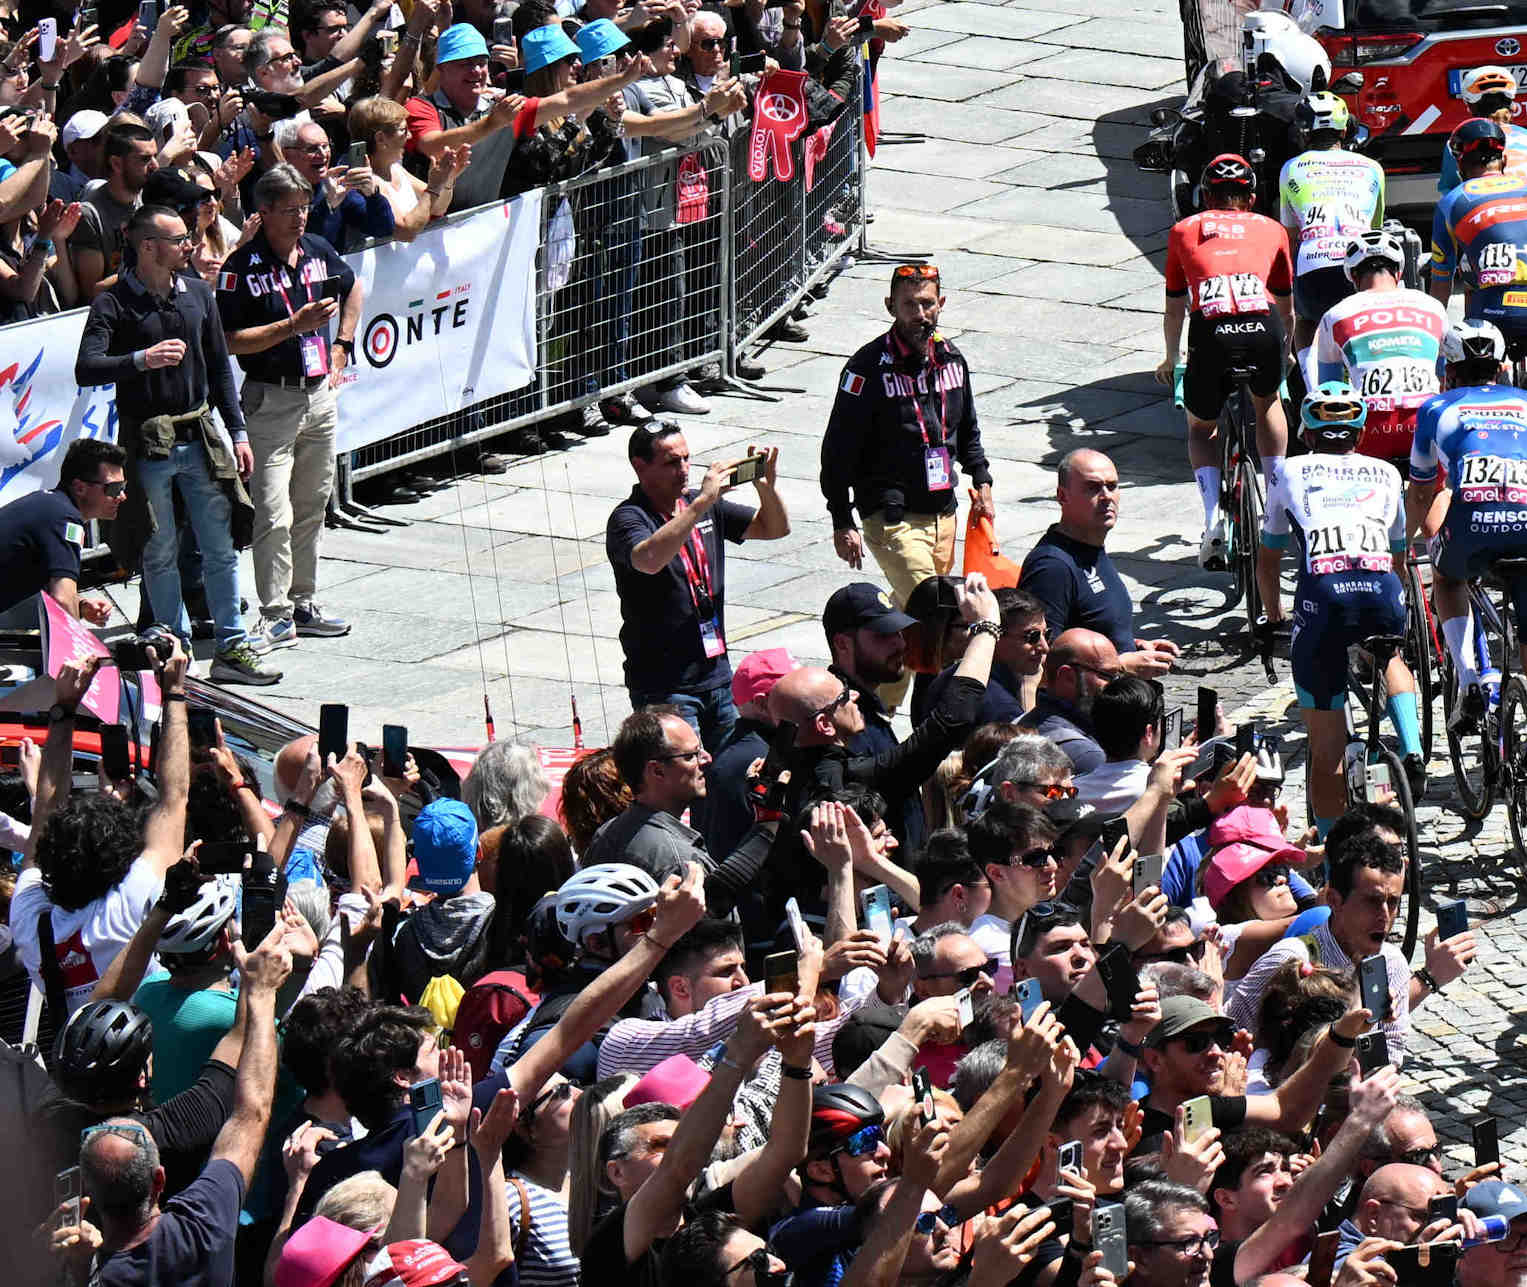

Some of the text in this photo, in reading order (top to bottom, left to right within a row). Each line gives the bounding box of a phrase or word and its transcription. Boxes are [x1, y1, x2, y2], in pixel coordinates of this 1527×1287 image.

[752, 127, 766, 175] TOYOTA
[1304, 205, 1327, 226] 94
[1480, 243, 1513, 269] 115
[1202, 279, 1225, 302] 22
[1214, 321, 1266, 335] ARKEA
[1353, 310, 1433, 331] POLTI
[1367, 337, 1423, 352] KOMETA
[1361, 367, 1394, 398] 162
[1301, 465, 1391, 480] BAHRAIN
[1462, 456, 1501, 486] 132
[1308, 525, 1344, 557] 211
